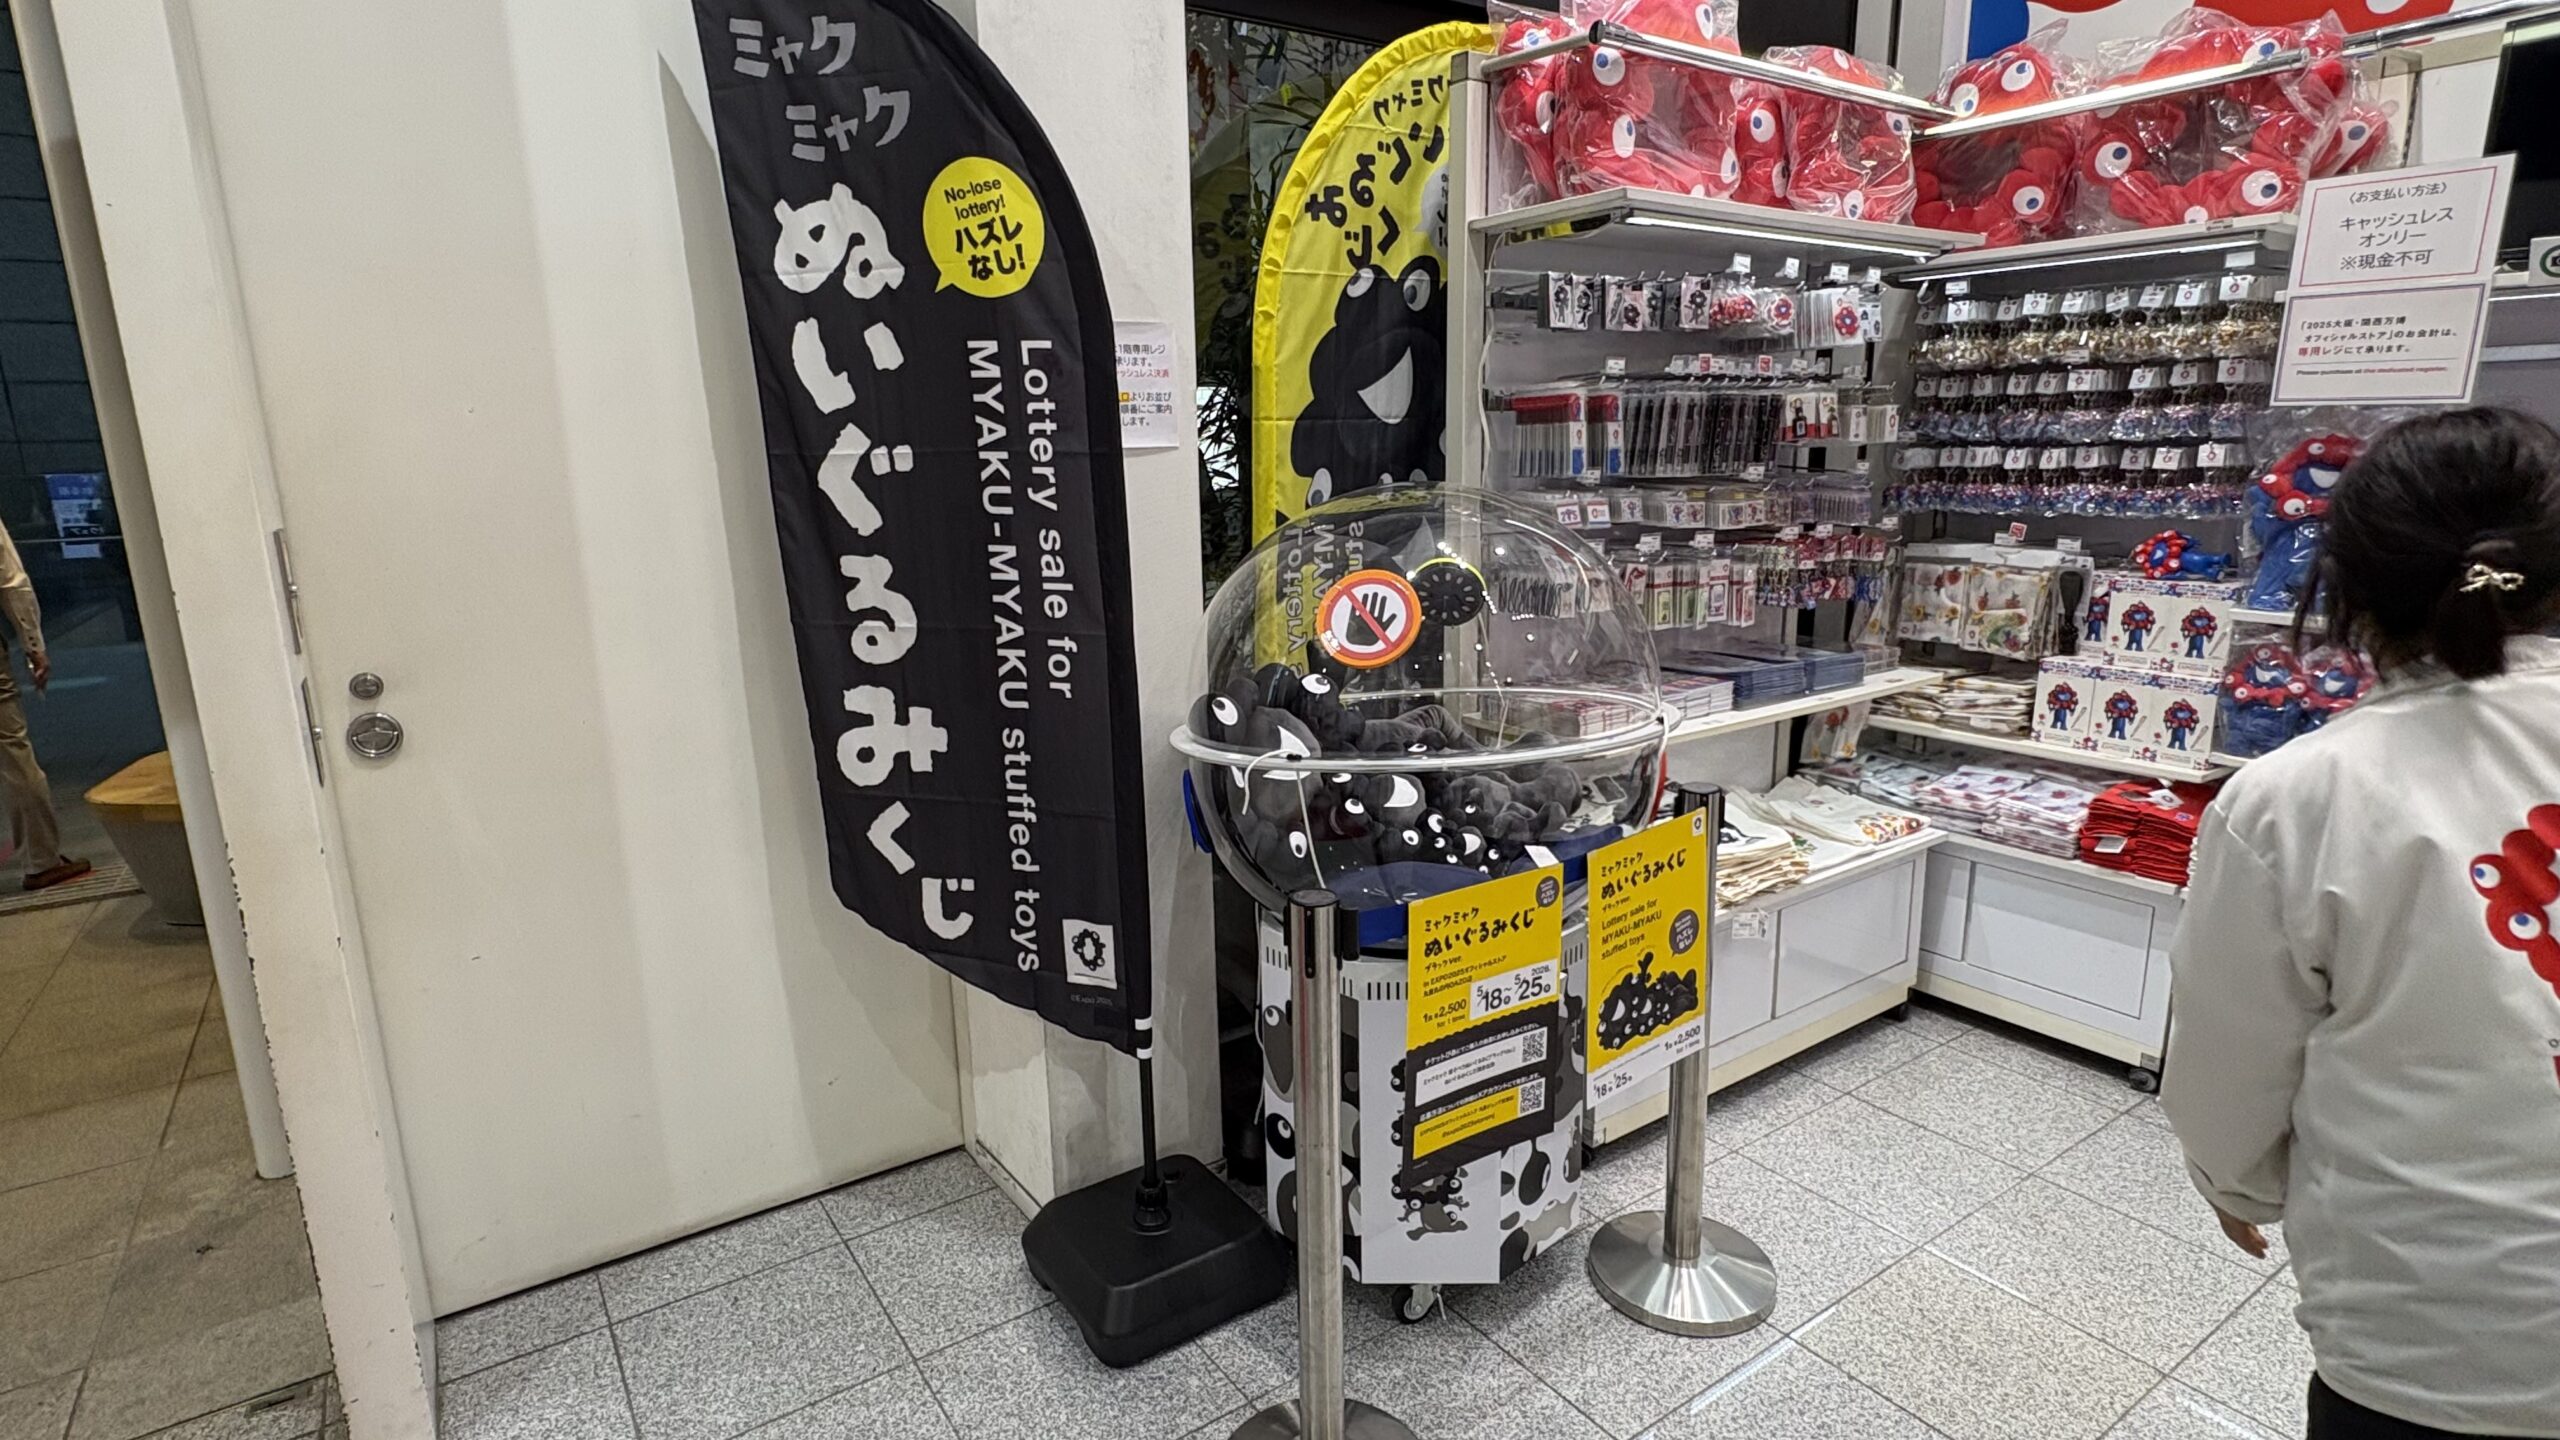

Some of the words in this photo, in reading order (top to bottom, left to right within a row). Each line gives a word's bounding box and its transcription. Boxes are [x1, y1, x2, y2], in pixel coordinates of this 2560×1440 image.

[729, 15, 857, 79] ミャク
[785, 85, 912, 162] ミャク
[944, 178, 1002, 203] No-lose
[954, 194, 1006, 221] lottery!
[955, 215, 1023, 254] ハズレ
[2339, 207, 2453, 231] キャッシュレス
[2359, 231, 2427, 248] オンリー
[2340, 249, 2435, 270] ※現金不可
[1020, 339, 1058, 511] Lottery
[966, 339, 1030, 710] MYAKU-MYAKU
[773, 181, 978, 942] ぬいぐるみくじ
[1038, 528, 1074, 620] sale
[1046, 636, 1079, 700] for
[1001, 727, 1041, 873] stuffed
[1600, 847, 1687, 900] ぬいぐるみくじ
[1601, 851, 1644, 878] ミャクミャク
[1009, 887, 1041, 973] toys
[1423, 906, 1536, 958] ぬいぐるみくじ
[1424, 906, 1480, 933] ミャクミャク
[1601, 910, 1662, 946] MYAKU-MYAKU
[1602, 912, 1628, 930] Lottery
[1629, 904, 1645, 917] sale
[1646, 898, 1658, 909] for
[1629, 933, 1645, 947] toys
